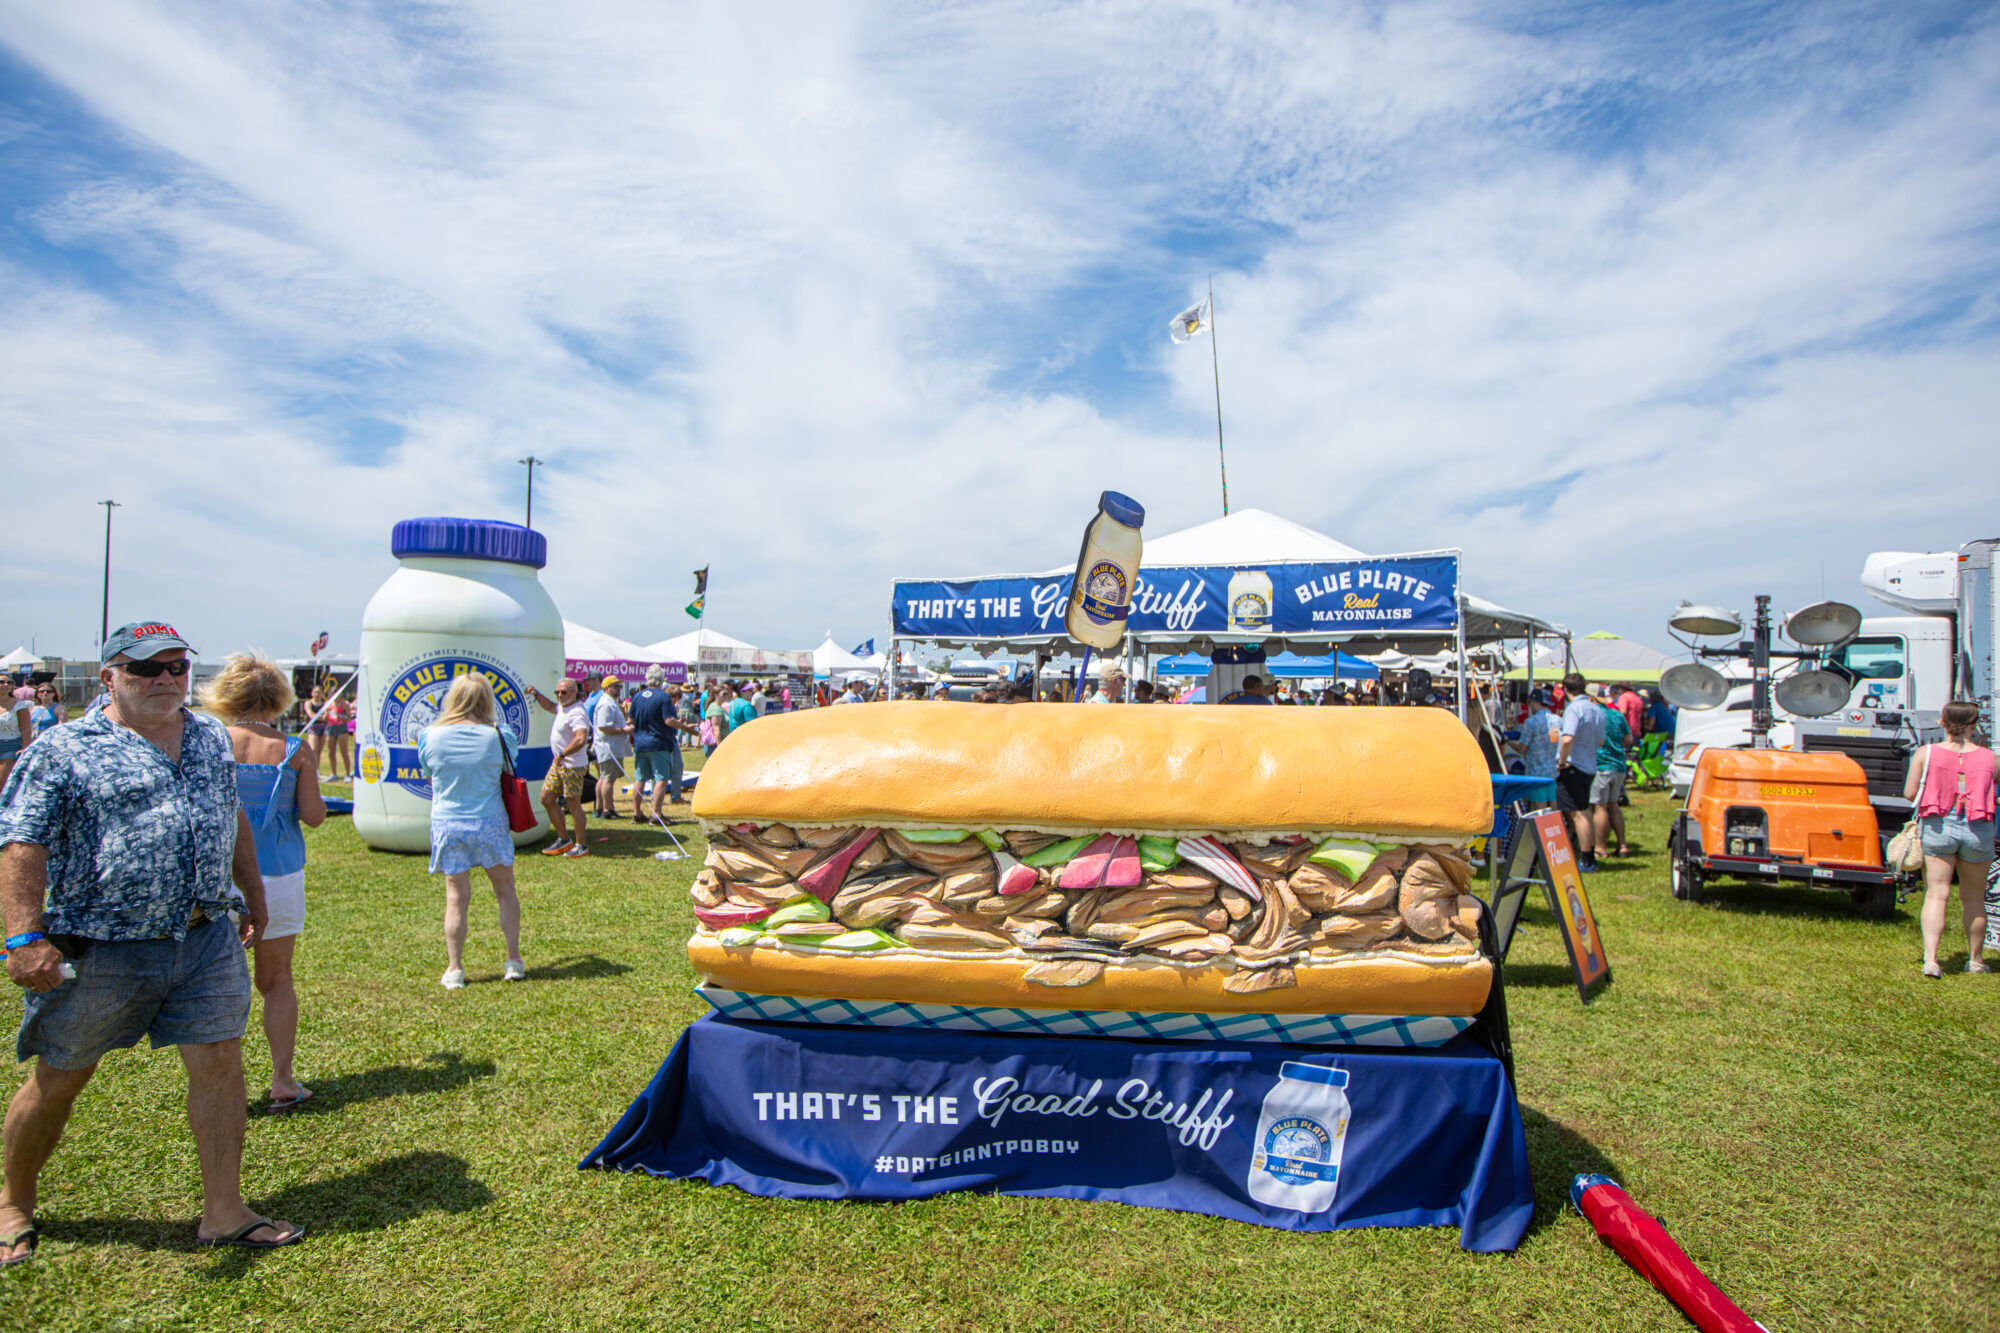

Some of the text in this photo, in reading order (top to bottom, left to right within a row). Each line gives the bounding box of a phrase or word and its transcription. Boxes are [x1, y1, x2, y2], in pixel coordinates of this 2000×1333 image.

[1093, 565, 1126, 588] BLUE PLATE
[1294, 570, 1432, 604] BLUE PLATE
[907, 598, 976, 619] THAT'S
[980, 597, 1021, 618] THE
[1031, 583, 1068, 630] Go
[1343, 592, 1380, 609] Real
[1312, 608, 1412, 621] MAYONNAISE
[423, 648, 457, 659] FAMILY
[462, 649, 511, 671] TRADITION
[394, 663, 448, 703] BLUE
[753, 1076, 1235, 1151] THAT'S THE Good Stuff
[1272, 1119, 1298, 1136] BLUE
[1300, 1120, 1329, 1144] PLATE
[874, 1139, 1080, 1173] #DATGIANTPOBOY
[1269, 1164, 1318, 1179] MAYONNAISE
